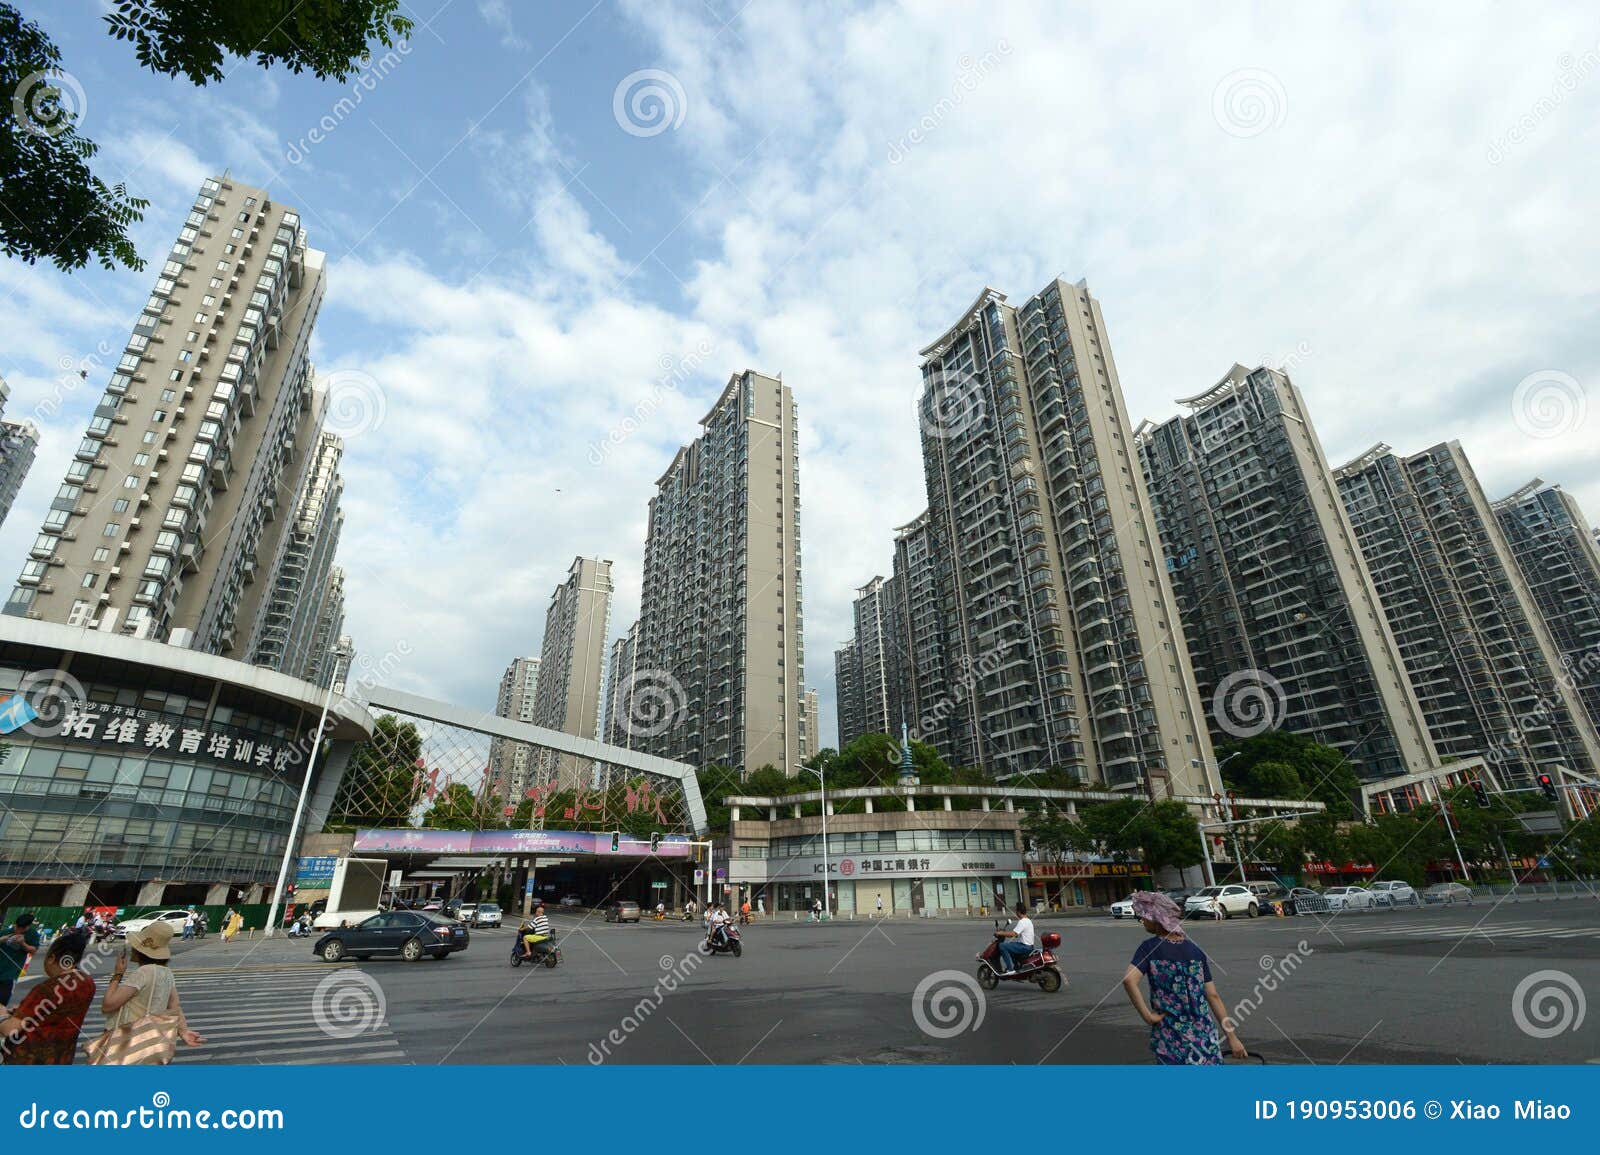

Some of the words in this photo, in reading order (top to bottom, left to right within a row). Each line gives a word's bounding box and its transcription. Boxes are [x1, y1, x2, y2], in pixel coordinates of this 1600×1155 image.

[72, 700, 146, 718] 长沙市开福区
[61, 710, 290, 771] 拓维教育培训学校
[814, 863, 838, 873] ICBC
[861, 858, 930, 871] 中国工商银行
